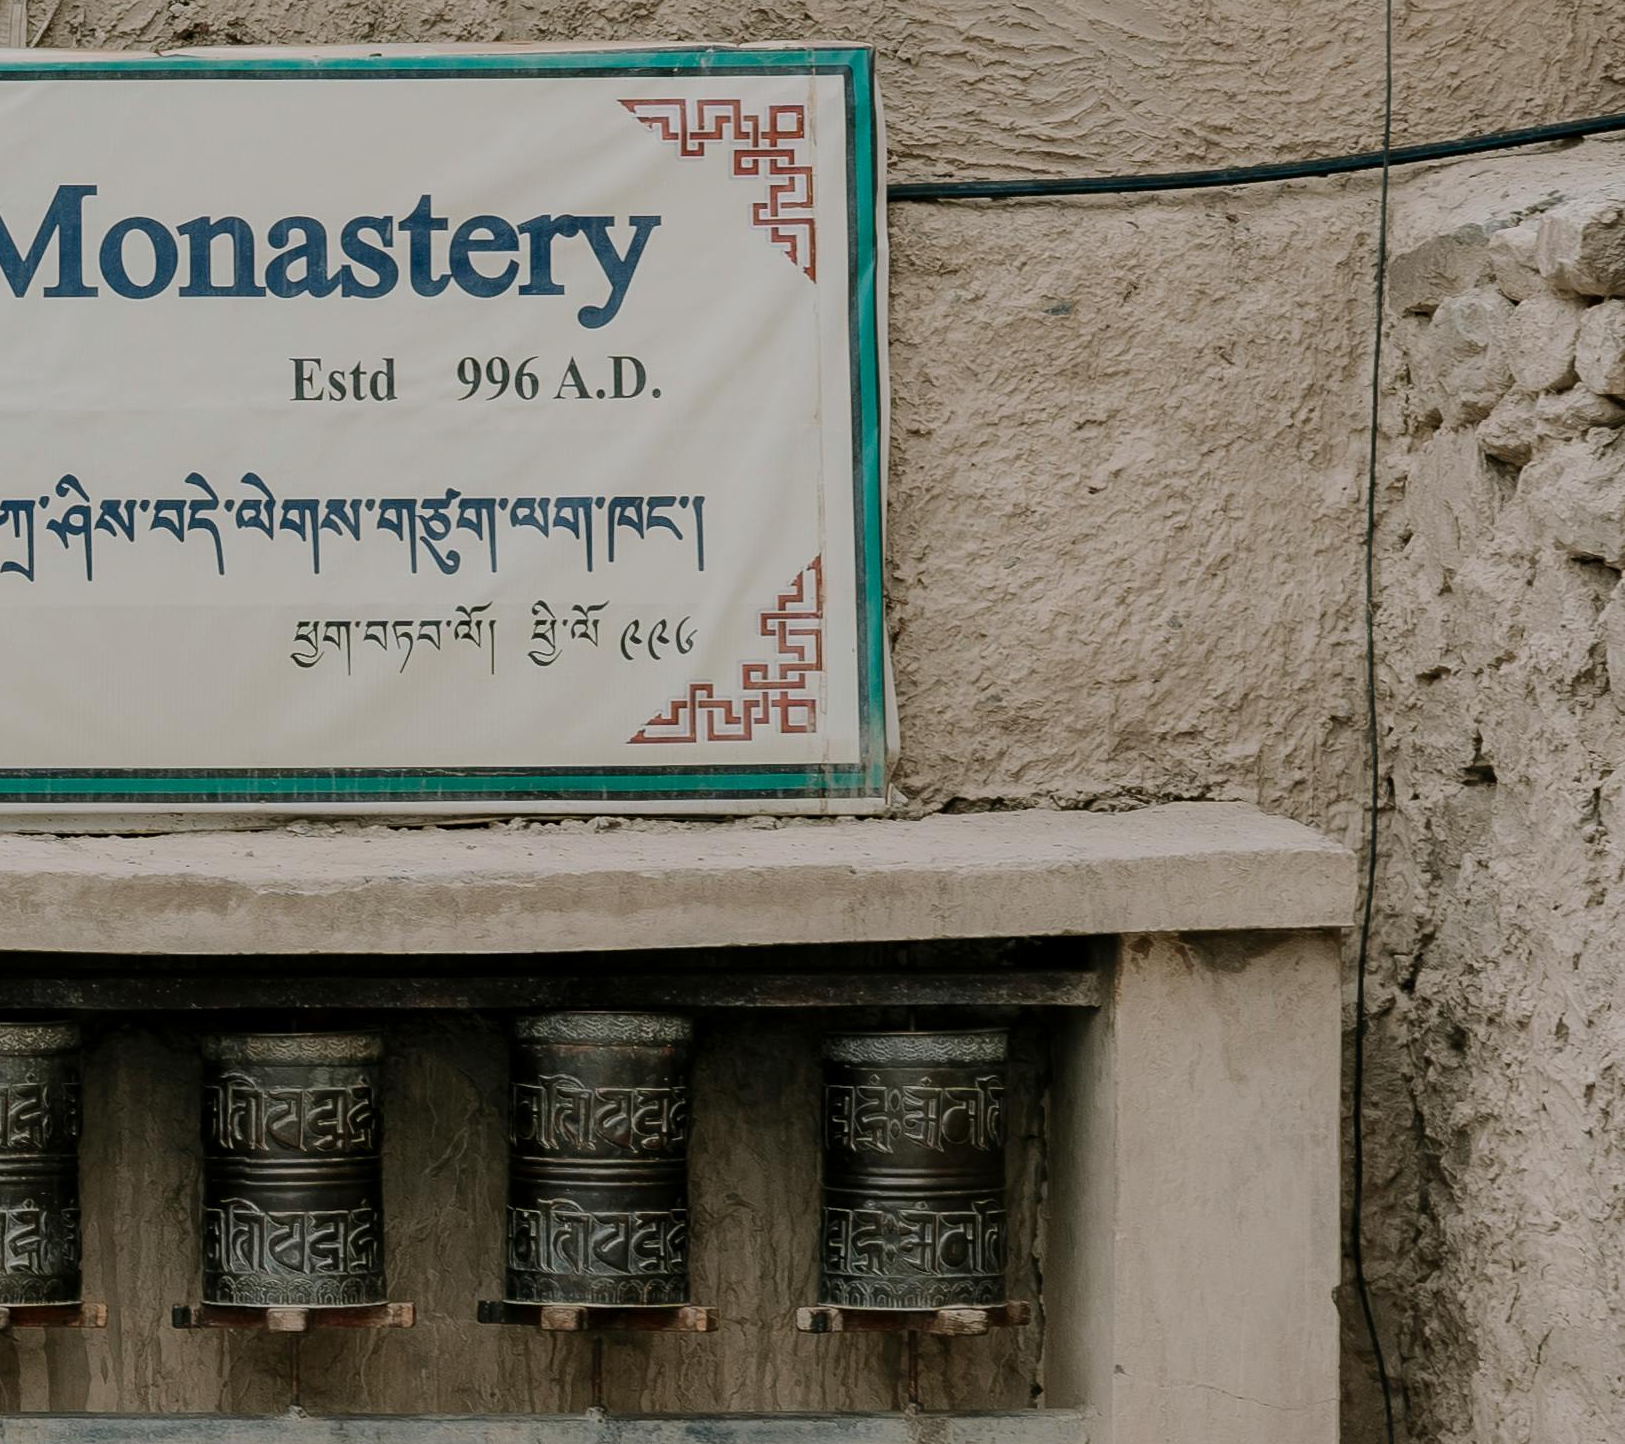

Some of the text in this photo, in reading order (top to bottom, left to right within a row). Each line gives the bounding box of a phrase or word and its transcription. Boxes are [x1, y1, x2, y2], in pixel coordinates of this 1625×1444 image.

[290, 355, 662, 403] Estd 996 A.D.
